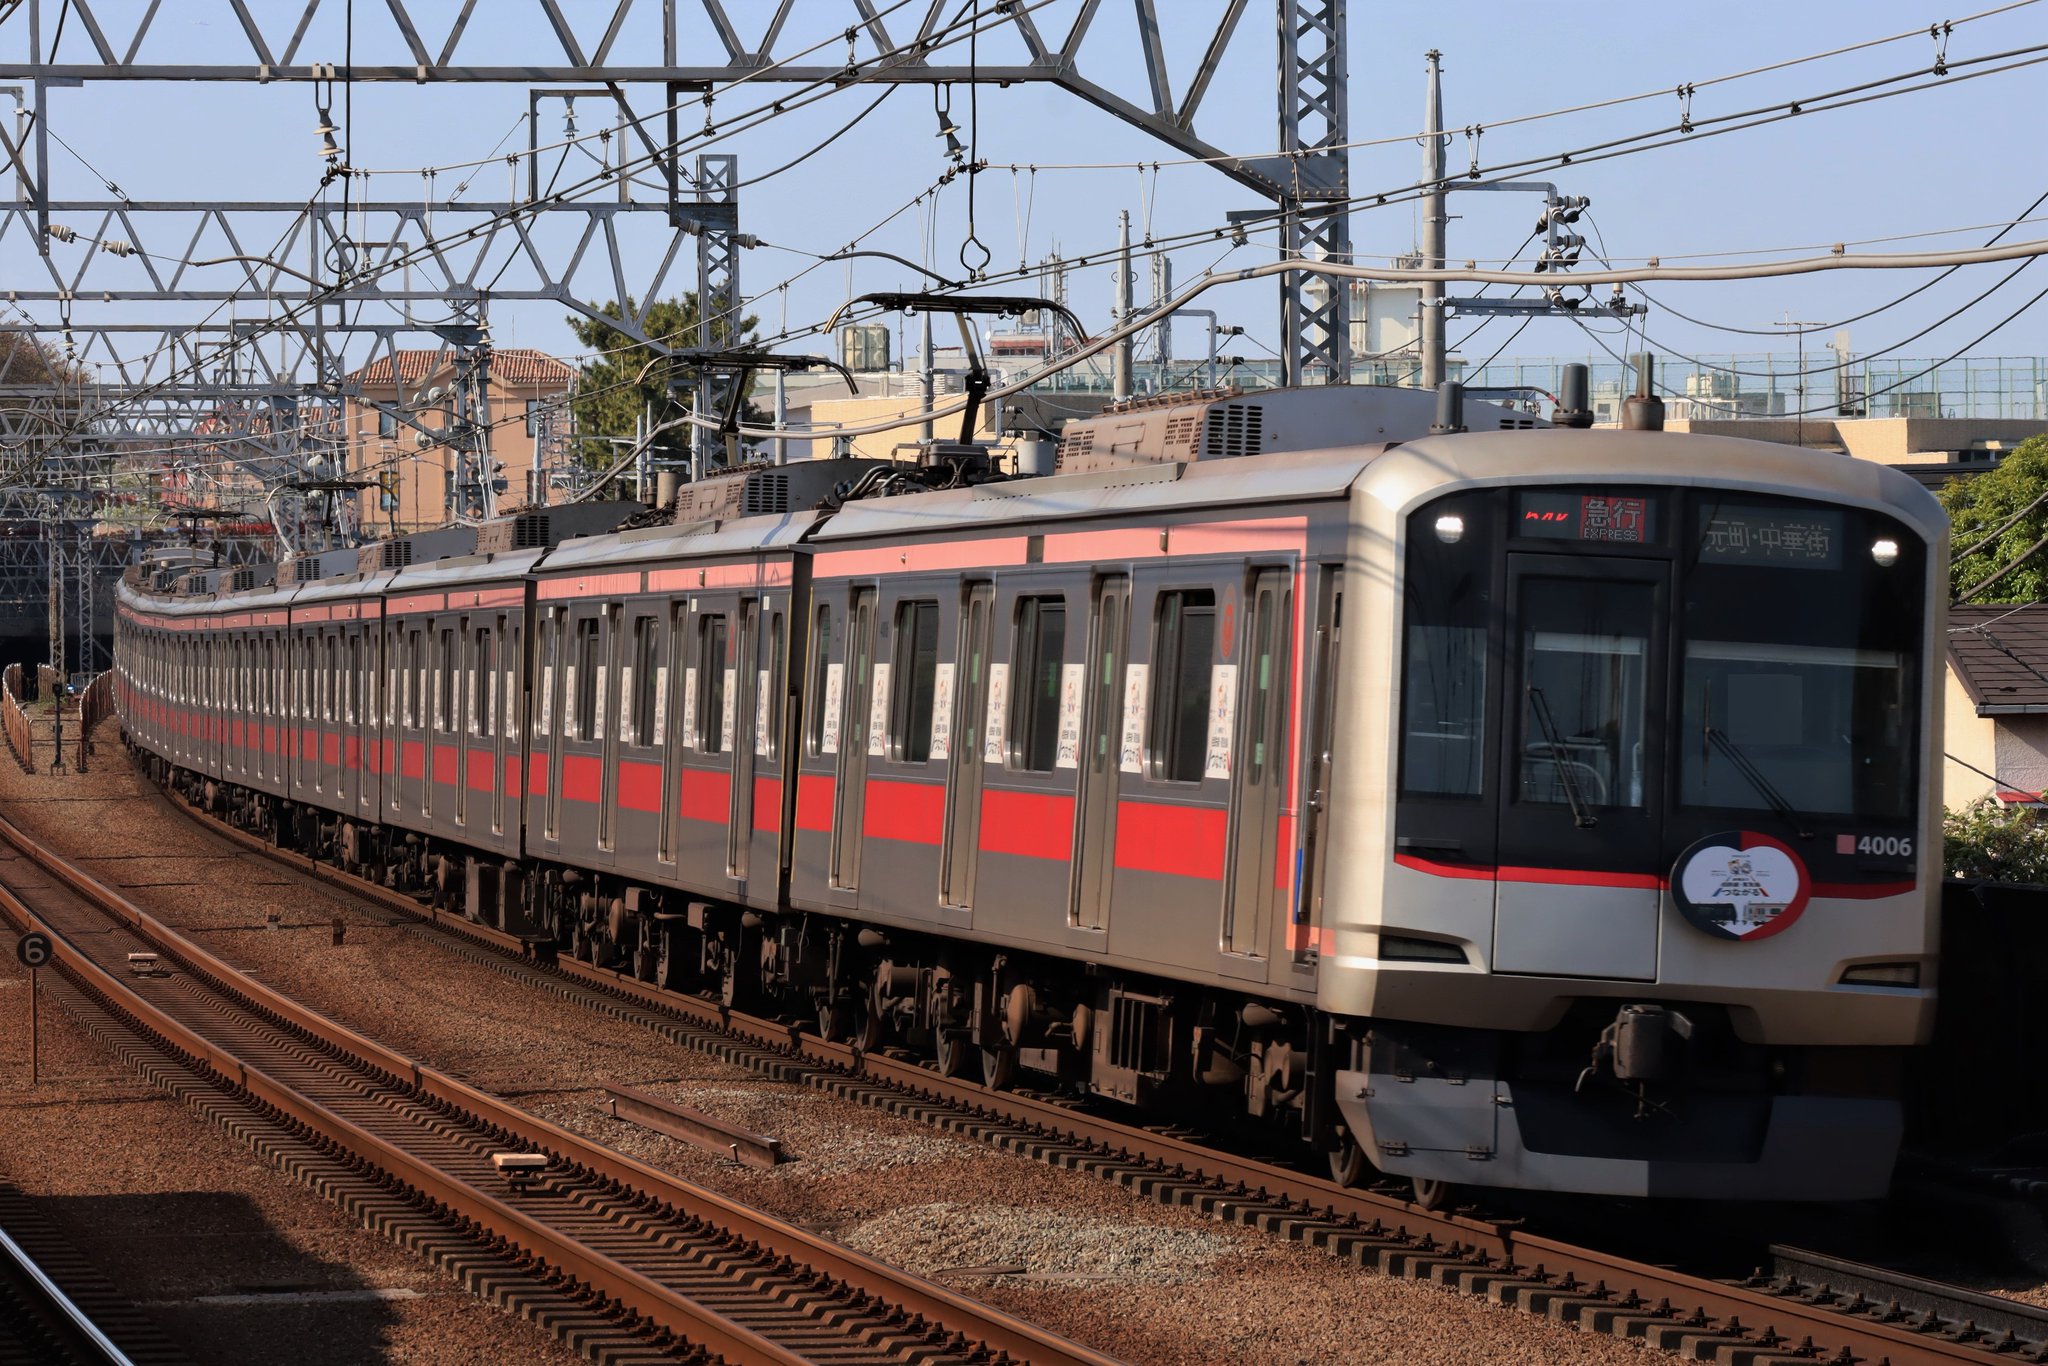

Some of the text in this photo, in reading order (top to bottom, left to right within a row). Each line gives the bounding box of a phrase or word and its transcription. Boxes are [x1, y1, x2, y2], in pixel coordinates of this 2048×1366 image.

[1585, 498, 1641, 529] 急行
[1583, 527, 1639, 541] EXPRESS
[1858, 836, 1912, 856] 4006
[25, 937, 44, 963] 6
